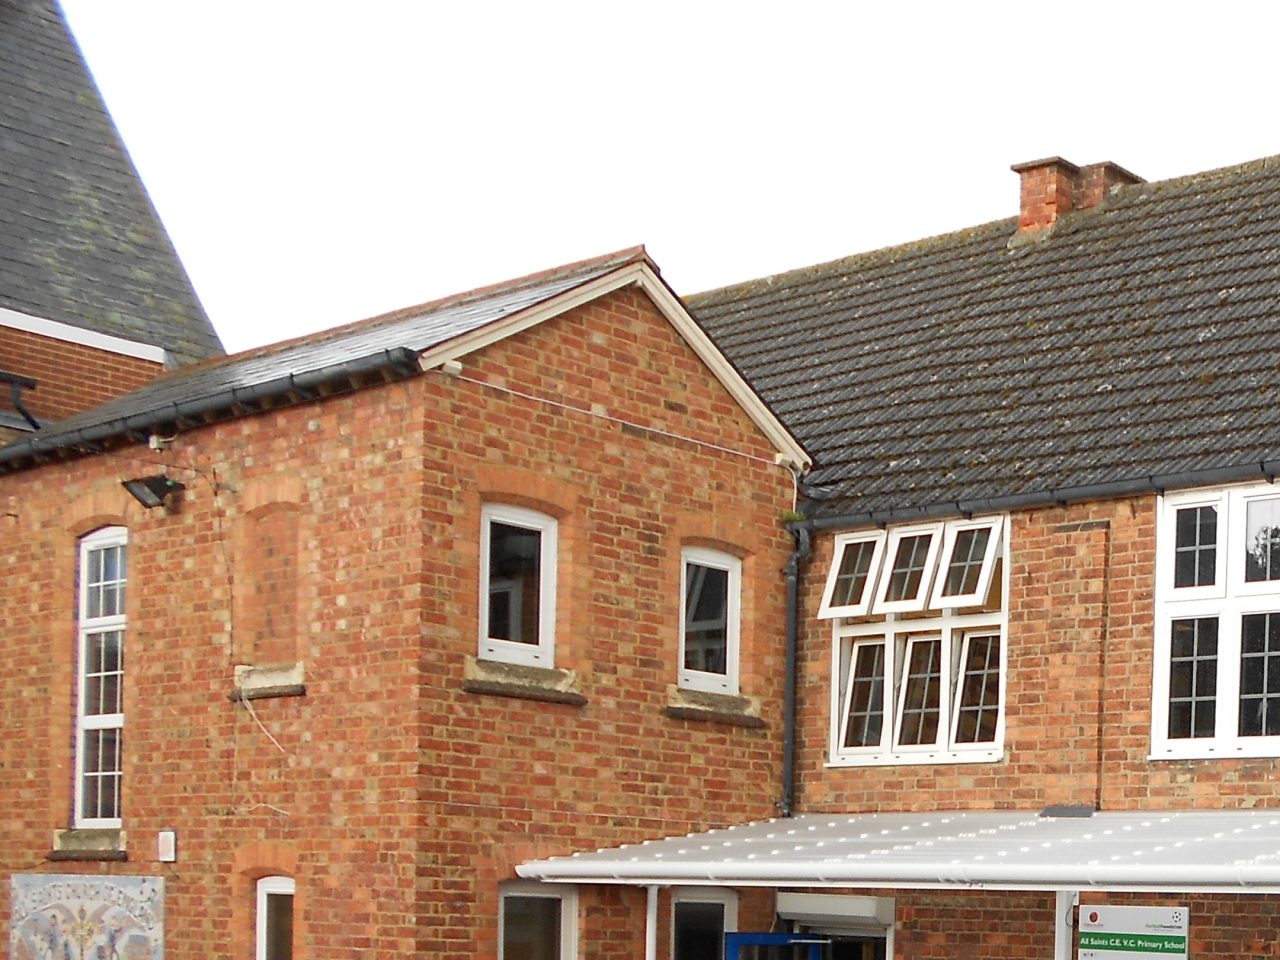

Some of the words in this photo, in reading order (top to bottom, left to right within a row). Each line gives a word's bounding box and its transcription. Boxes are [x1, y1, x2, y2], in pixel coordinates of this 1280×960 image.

[1090, 938, 1108, 946] Saints
[1137, 941, 1163, 950] Primary
[1164, 941, 1185, 949] School
